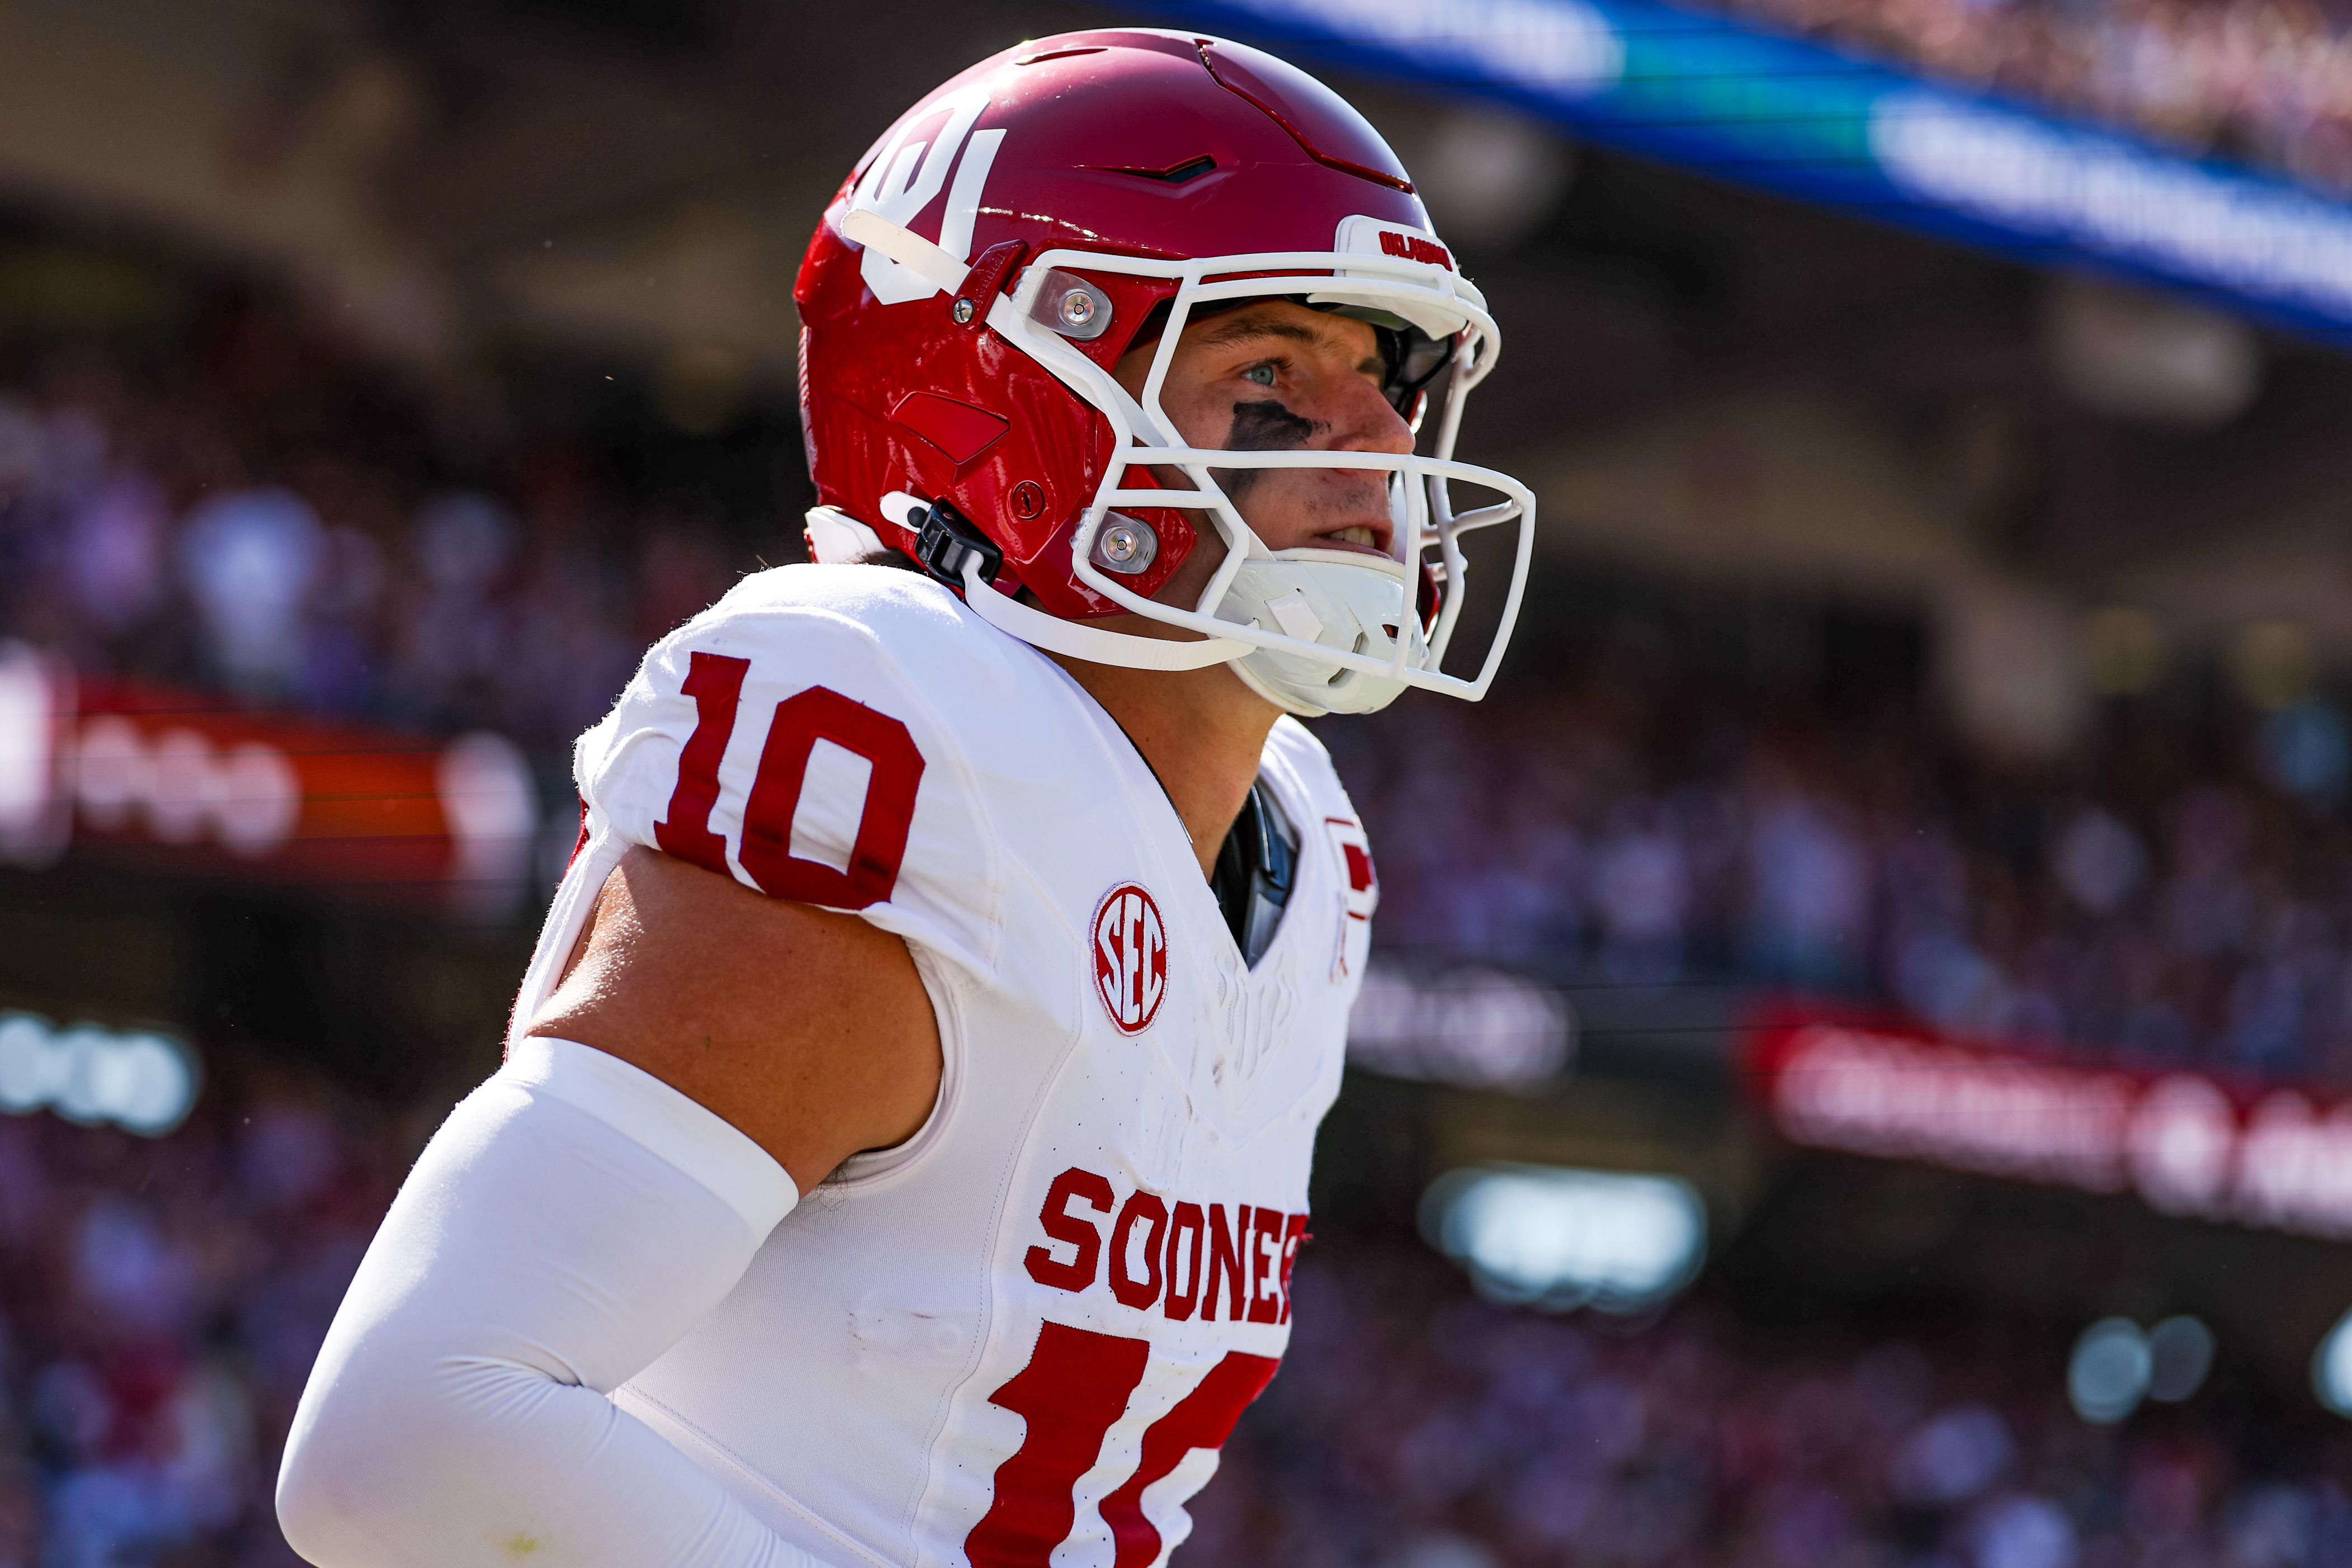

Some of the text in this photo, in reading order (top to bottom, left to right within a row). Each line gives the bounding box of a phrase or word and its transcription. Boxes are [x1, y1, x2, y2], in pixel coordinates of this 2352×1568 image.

[1378, 231, 1453, 272] OKLAHOMA
[653, 651, 926, 910] 10
[1098, 893, 1163, 1024] SEC
